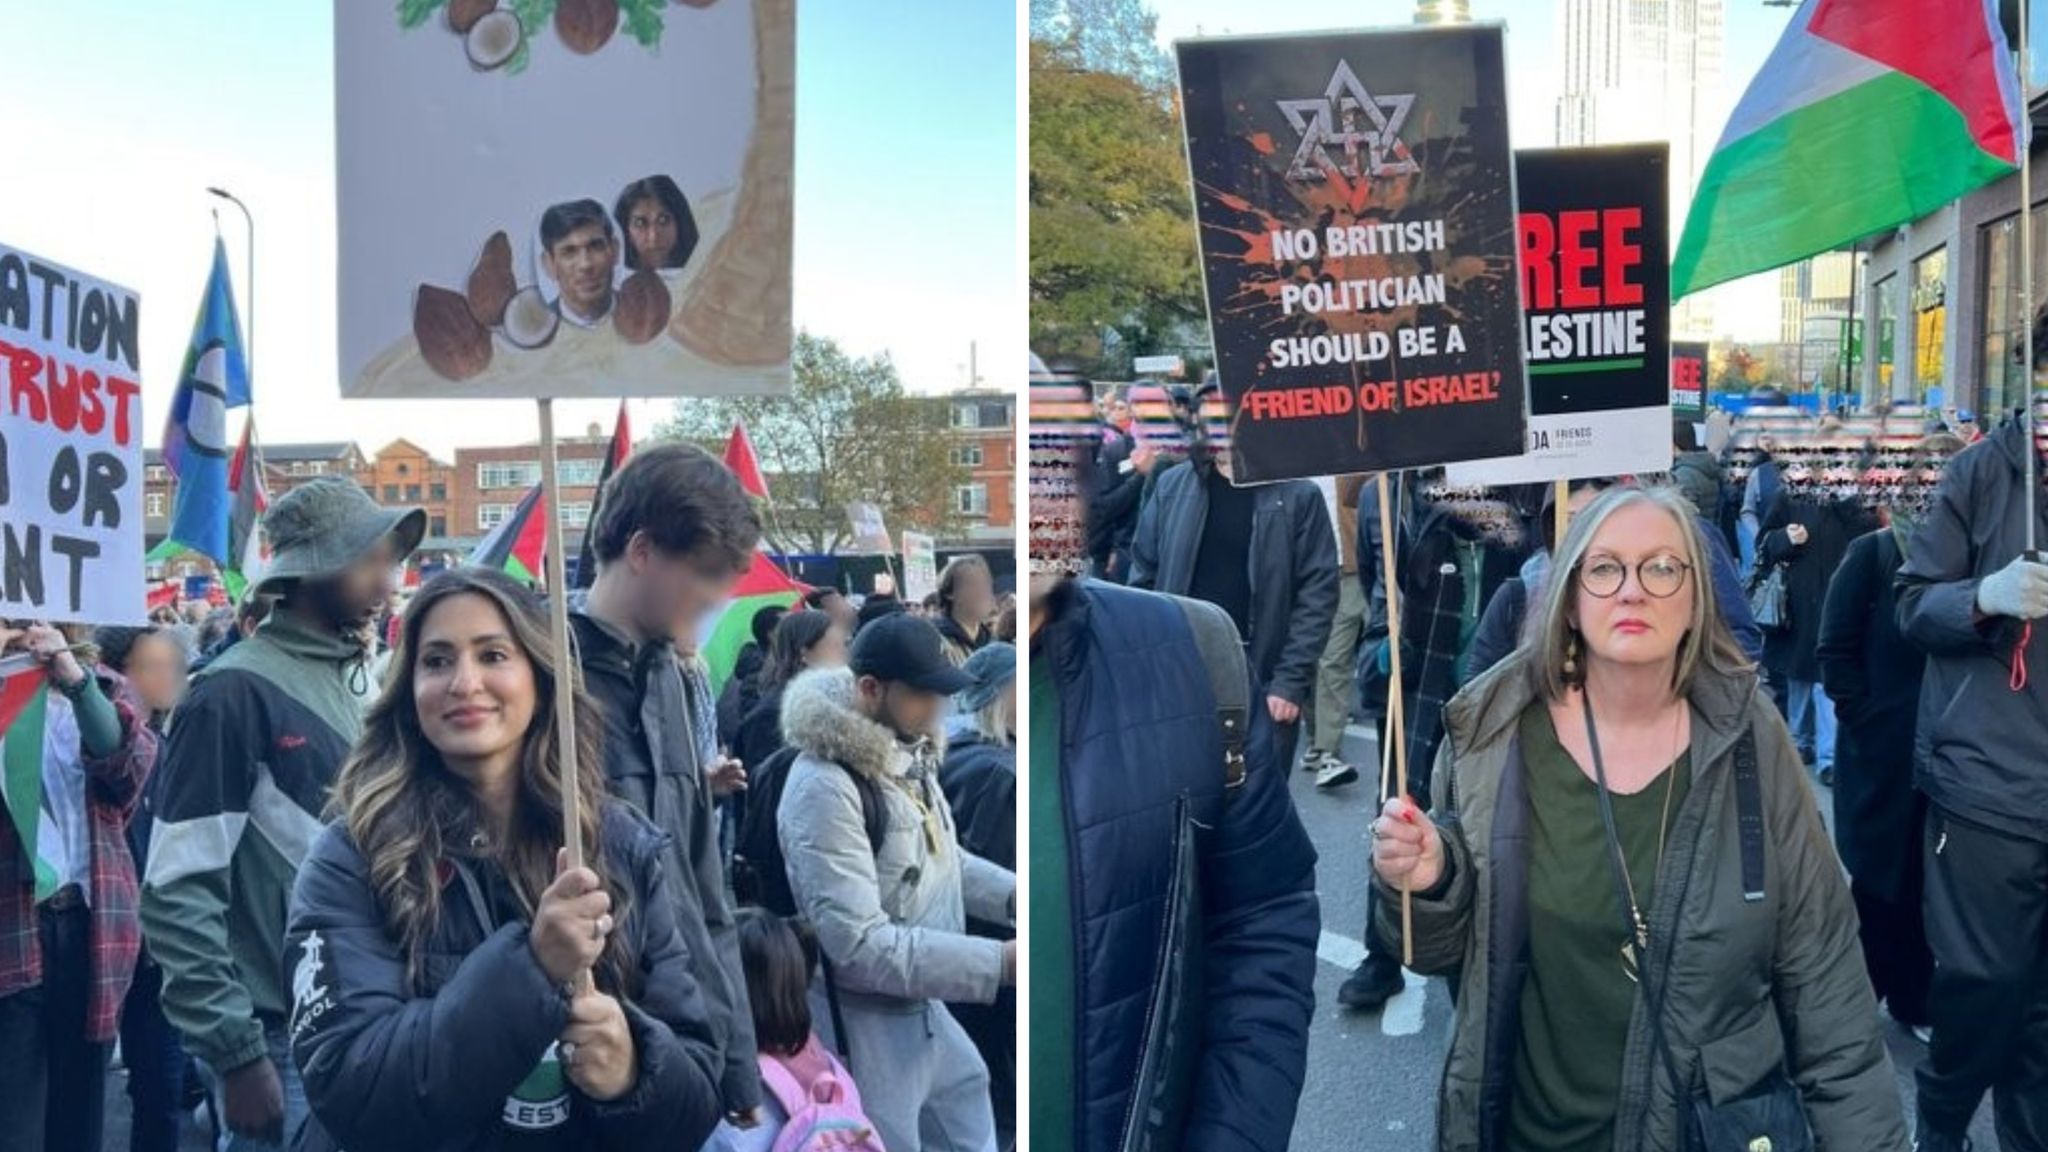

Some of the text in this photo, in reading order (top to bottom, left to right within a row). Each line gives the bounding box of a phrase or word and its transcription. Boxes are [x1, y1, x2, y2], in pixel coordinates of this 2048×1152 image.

[1271, 219, 1445, 261] NO BRITISH
[1281, 274, 1446, 315] POLITICIAN
[1270, 325, 1467, 368] SHOULD BE A
[1360, 381, 1398, 411] OF
[48, 444, 128, 529] OR
[0, 522, 101, 613] NT
